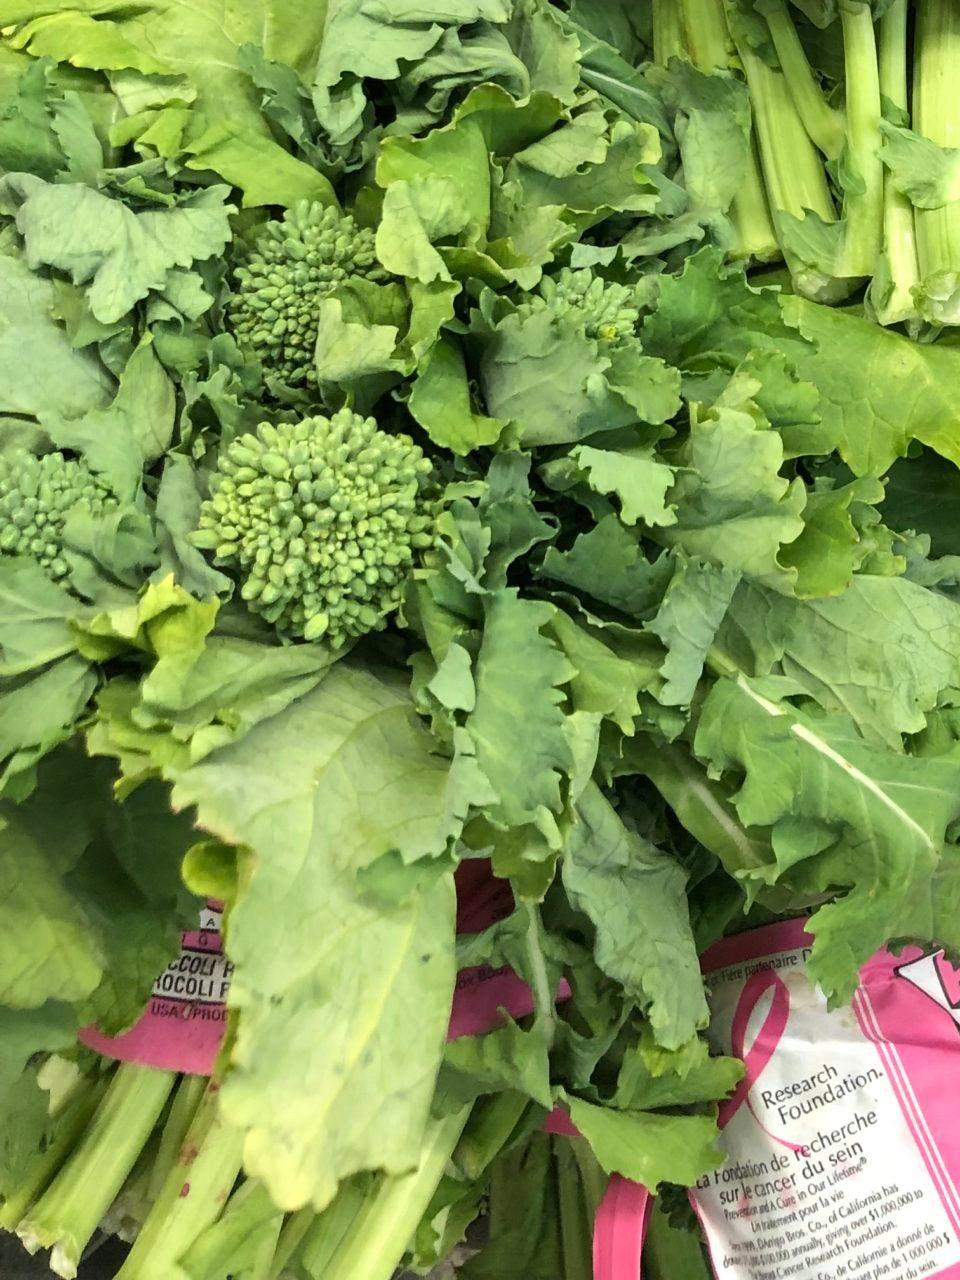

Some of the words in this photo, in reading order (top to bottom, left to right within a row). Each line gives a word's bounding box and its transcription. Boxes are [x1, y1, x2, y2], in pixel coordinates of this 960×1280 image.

[761, 1063, 838, 1109] Research
[777, 1068, 884, 1126] Foundation.
[771, 1153, 791, 1172] de
[794, 1110, 879, 1162] recherche
[720, 1187, 739, 1205] sur
[741, 1181, 753, 1200] le
[754, 1173, 797, 1198] cancer
[802, 1159, 826, 1180] du
[828, 1141, 863, 1167] sein
[776, 1197, 797, 1210] Cure
[797, 1190, 807, 1202] in
[808, 1180, 826, 1196] Our
[799, 1201, 819, 1221] pour
[819, 1196, 830, 1208] la
[830, 1190, 844, 1202] vie
[825, 1224, 851, 1245] giving
[851, 1215, 868, 1230] over
[914, 1189, 924, 1200] to
[828, 1210, 838, 1224] of
[838, 1190, 882, 1218] California
[882, 1183, 899, 1197] has
[804, 1245, 845, 1268] Research
[845, 1220, 898, 1251] Foundation.
[836, 1265, 847, 1276] de
[847, 1246, 889, 1272] Californie
[923, 1222, 935, 1236] de
[891, 1257, 902, 1269] de
[906, 1268, 918, 1280] du
